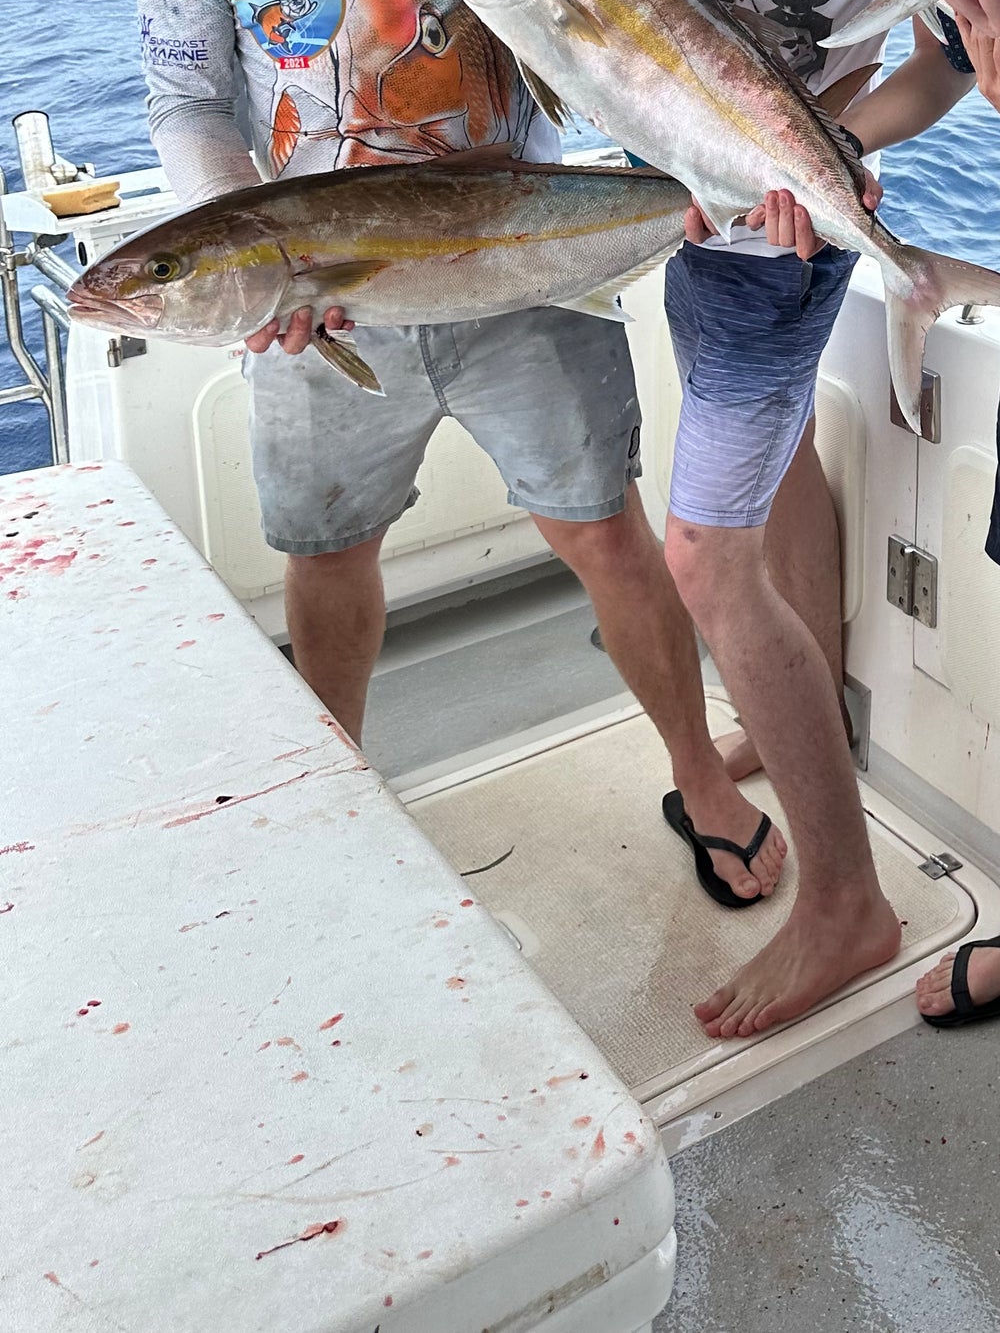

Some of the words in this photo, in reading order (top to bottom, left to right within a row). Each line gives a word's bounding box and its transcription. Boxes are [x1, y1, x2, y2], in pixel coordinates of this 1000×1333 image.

[149, 37, 208, 49] SUNCOAST
[149, 46, 209, 61] MARINE
[283, 57, 305, 68] 2021
